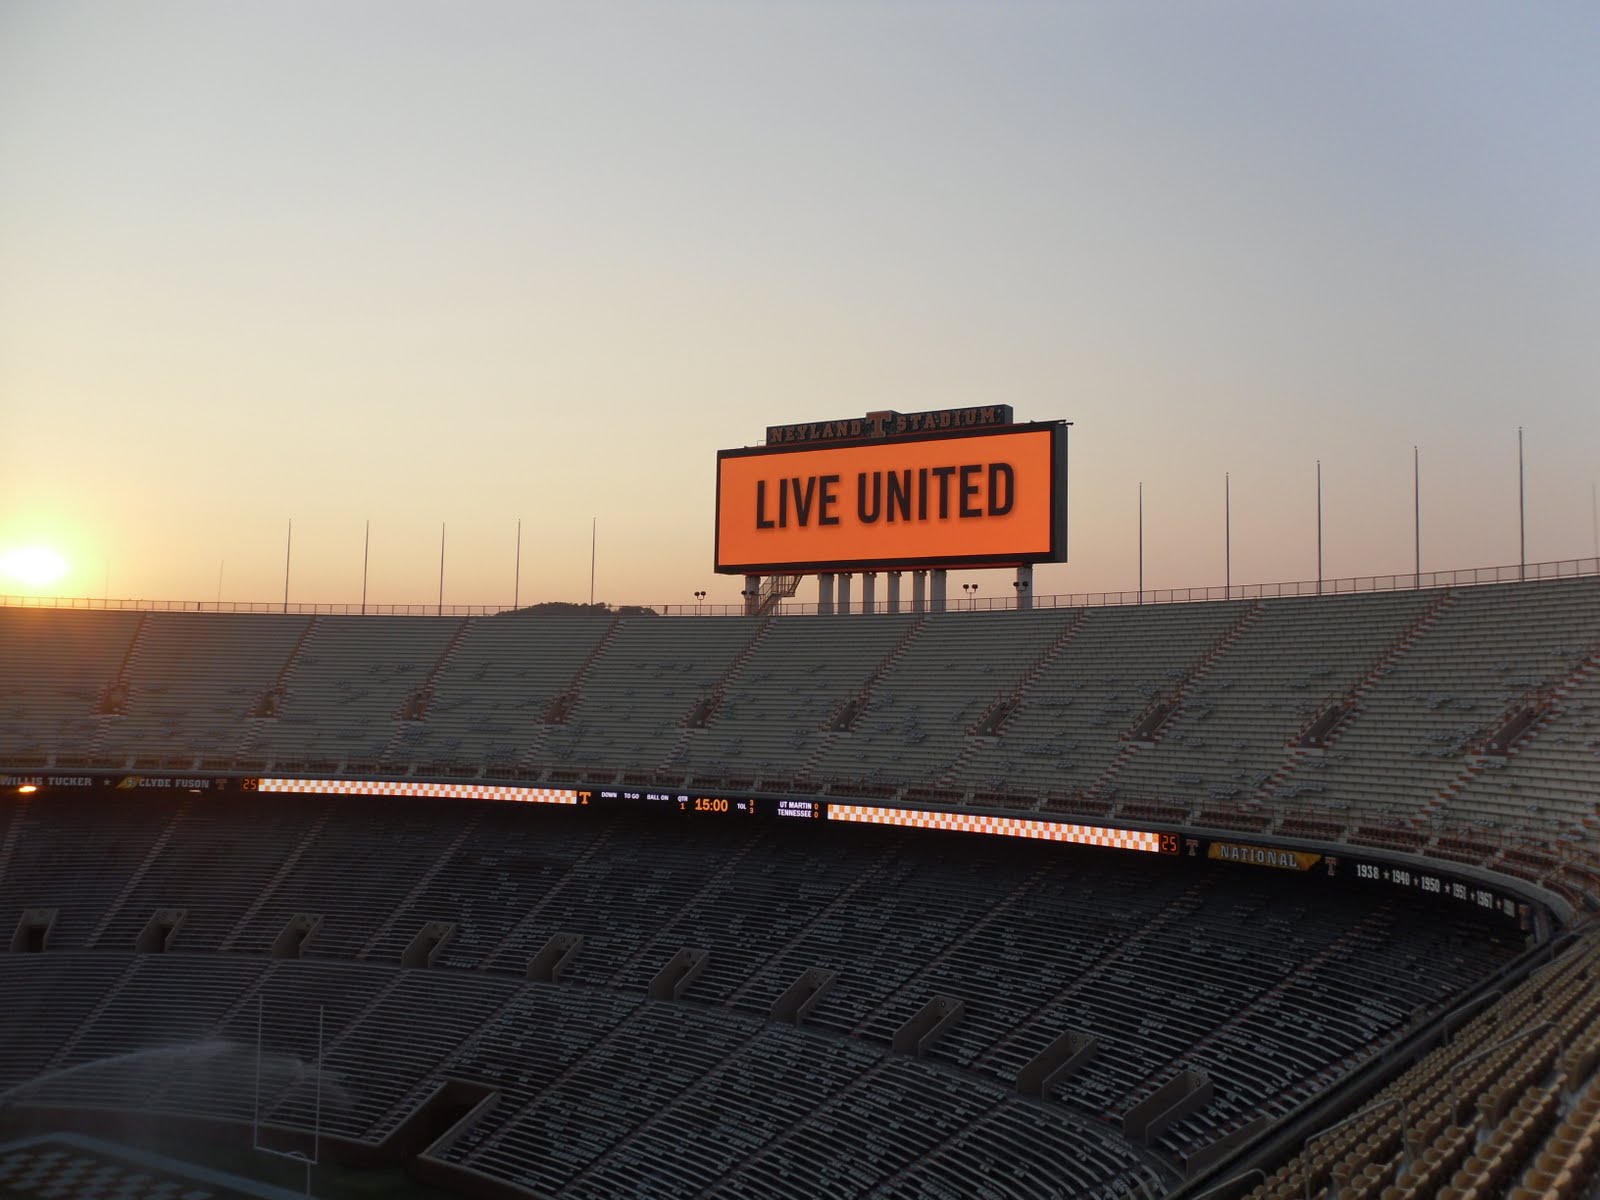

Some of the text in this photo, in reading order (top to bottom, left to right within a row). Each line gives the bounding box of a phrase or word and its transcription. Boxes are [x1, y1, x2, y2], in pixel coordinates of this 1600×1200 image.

[771, 407, 997, 443] NEYLAND T STADIUM
[757, 462, 1015, 529] LIVE UNITED
[49, 776, 92, 786] TUCKER
[139, 778, 171, 788] CLYDE
[175, 779, 210, 789] FUSON
[243, 778, 257, 790] 25
[579, 791, 591, 804] T
[646, 793, 660, 801] BALL
[677, 795, 688, 803] QTR
[695, 798, 729, 812] 15:00
[737, 802, 747, 810] TOL
[779, 800, 787, 809] UT
[788, 801, 812, 810] MARTIN
[777, 808, 812, 818] TENNESSEE
[1161, 834, 1177, 852] 25
[1220, 845, 1298, 868] NATIONAL
[1356, 863, 1379, 879] 1938
[1392, 869, 1410, 886] 1940
[1421, 876, 1440, 893] 1950
[1452, 883, 1467, 900] 1951
